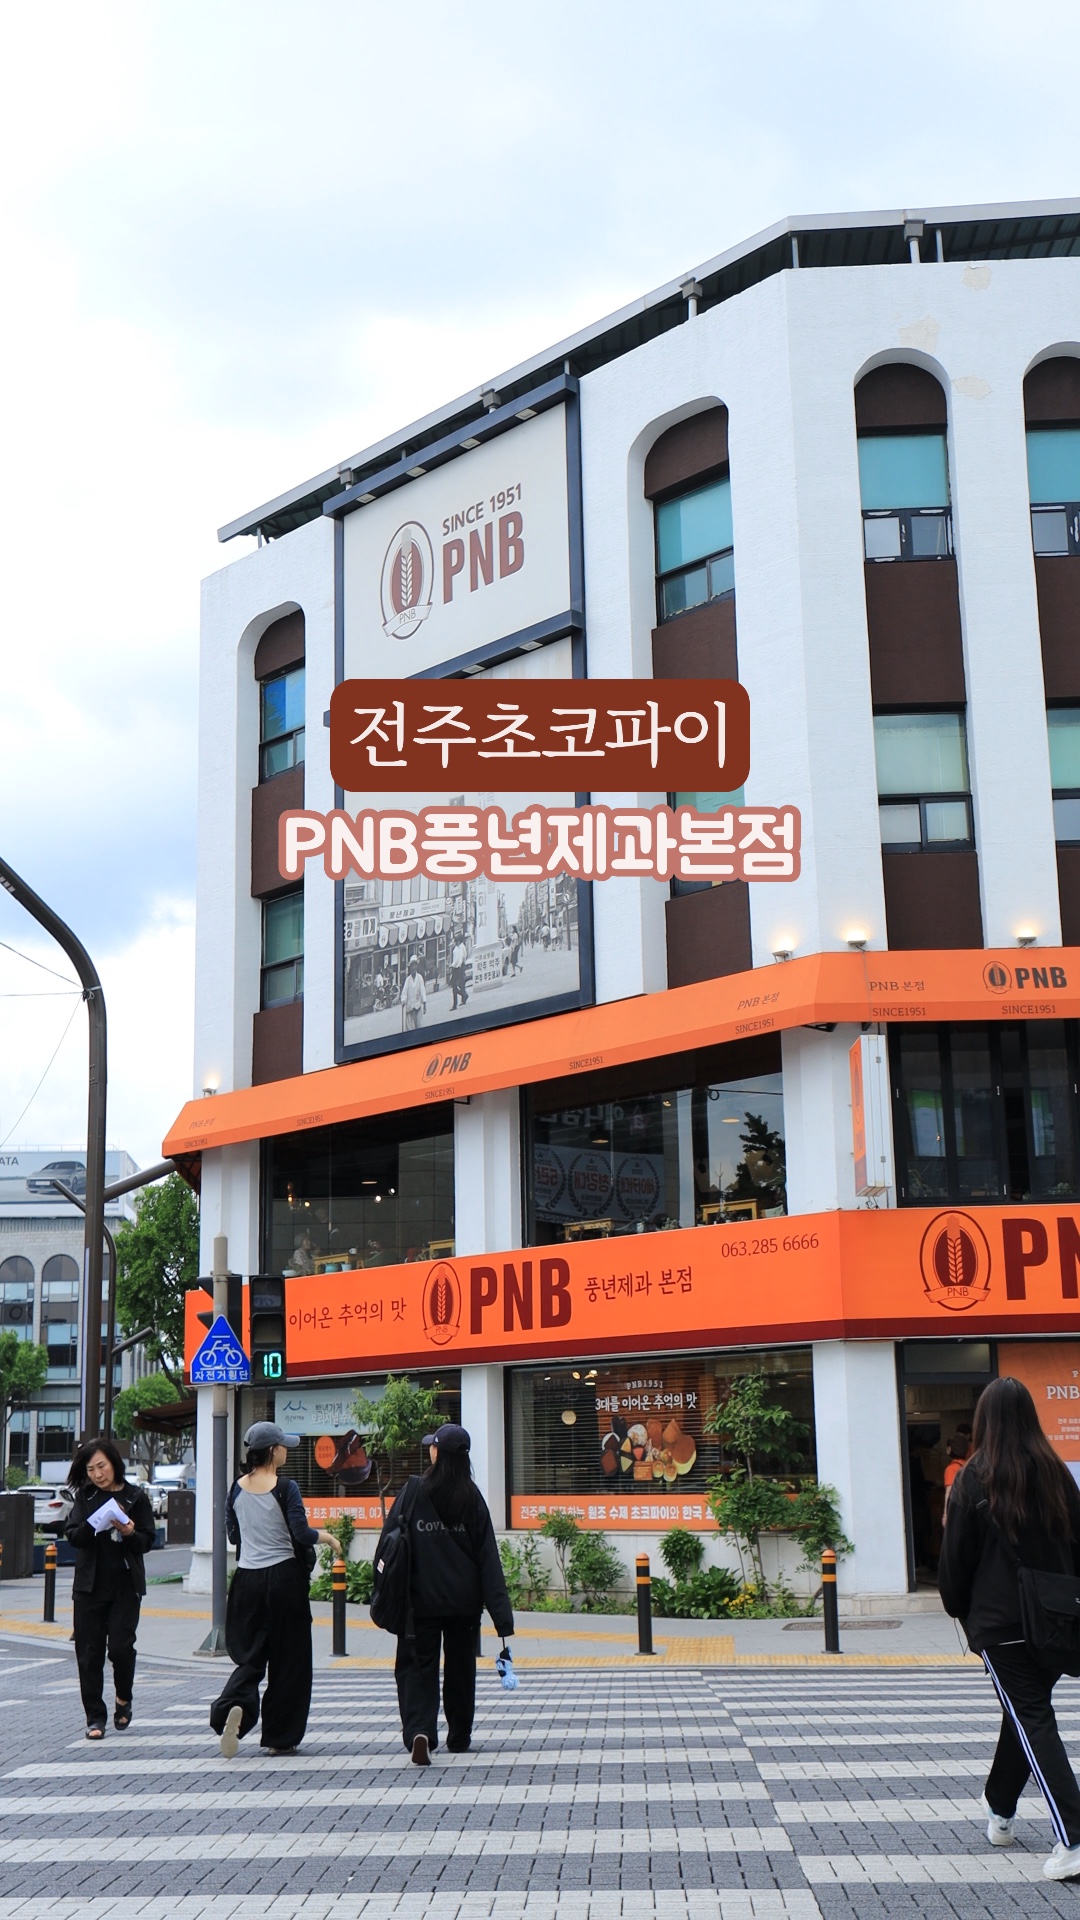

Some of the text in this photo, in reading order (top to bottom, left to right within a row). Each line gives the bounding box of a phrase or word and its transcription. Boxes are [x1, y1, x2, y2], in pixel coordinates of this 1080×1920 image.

[442, 482, 522, 536] SINCE 1951
[442, 510, 525, 605] PNB
[399, 608, 417, 625] PNB
[1015, 966, 1068, 989] PNB
[869, 981, 925, 991] PNB 본점
[737, 996, 760, 1010] PNB
[1002, 1004, 1056, 1015] SINCE1951
[872, 1007, 927, 1017] SINCE1951
[735, 1018, 775, 1035] SINCE1951
[439, 1052, 472, 1076] PNB
[569, 1056, 604, 1070] SINCE1951
[425, 1087, 455, 1100] SINCE1951
[721, 1233, 819, 1258] 063.285 6666
[584, 1265, 692, 1302] 풍년제과 본점
[470, 1257, 572, 1335] PNB
[947, 1287, 969, 1297] PNB
[289, 1297, 407, 1331] 이어온 추억의 맛
[435, 1325, 449, 1334] PNB
[263, 1352, 282, 1378] 10
[194, 1369, 249, 1381] 자전거횡단
[626, 1380, 664, 1391] PNB1951
[595, 1392, 698, 1413] 3대를 이어온 추억의 맛
[313, 1506, 327, 1519] 최초
[588, 1506, 606, 1520] 원조
[609, 1506, 629, 1520] 수제
[631, 1506, 680, 1520] 초코파이와
[682, 1506, 703, 1520] 한국
